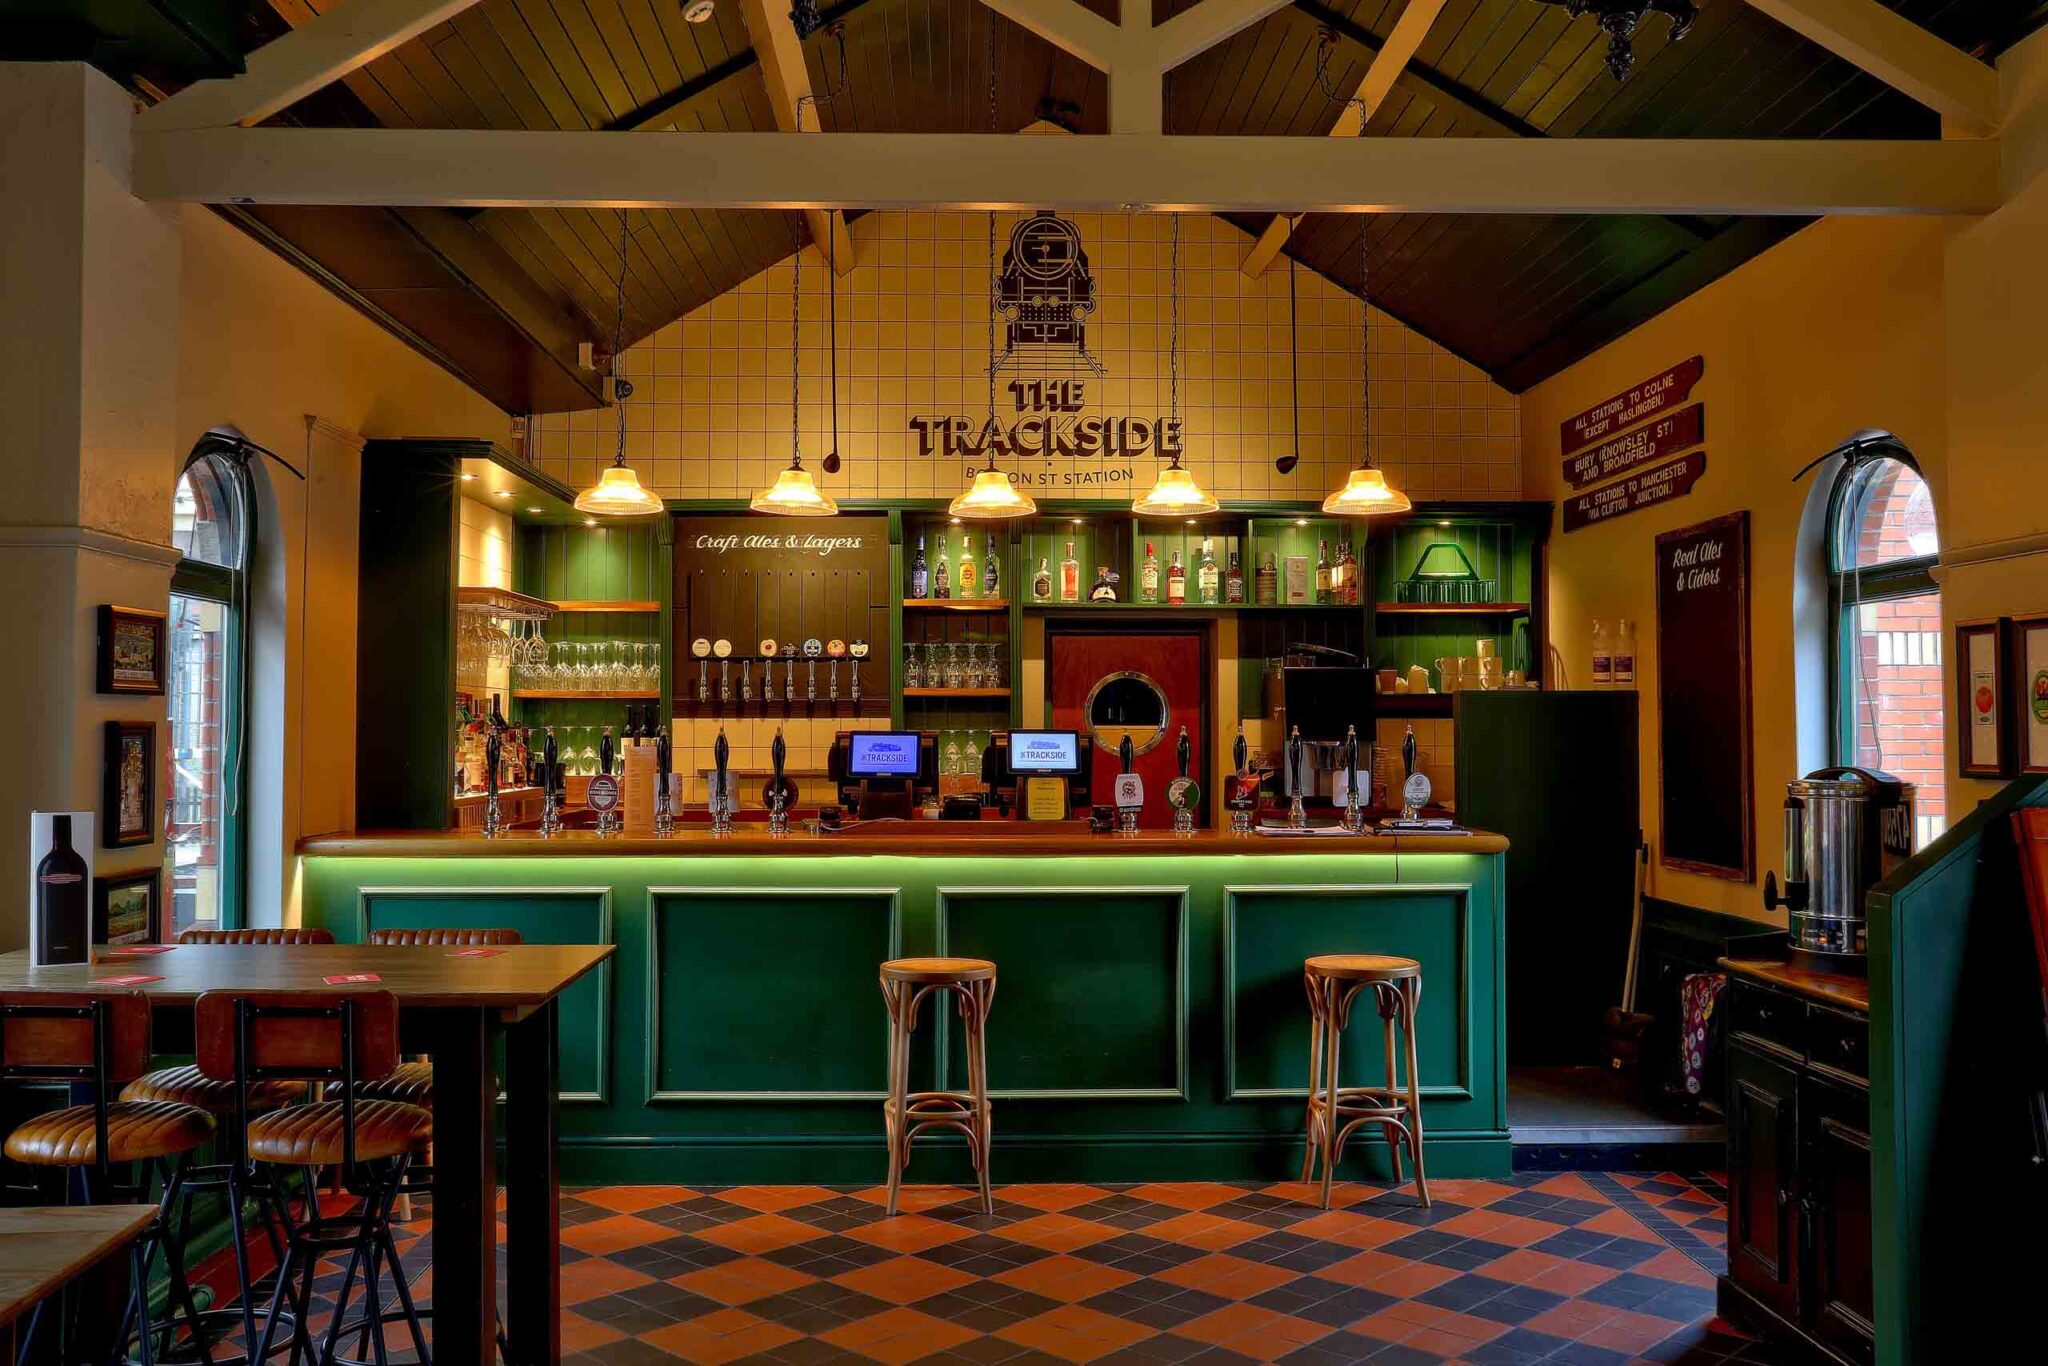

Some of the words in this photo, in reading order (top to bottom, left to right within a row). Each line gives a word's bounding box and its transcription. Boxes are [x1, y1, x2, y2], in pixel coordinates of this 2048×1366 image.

[1008, 379, 1085, 412] THE
[1575, 415, 1587, 431] ALL
[1592, 399, 1624, 423] STATIONS
[1629, 391, 1640, 405] TO
[1644, 374, 1675, 398] COLNE
[909, 414, 1183, 457] TRACKSIDE
[966, 467, 1032, 485] BON
[1038, 473, 1058, 485] ST
[1064, 468, 1134, 485] STATION
[1575, 453, 1595, 473] BURY
[1583, 465, 1599, 482] AND
[1603, 442, 1656, 473] BROADFIELD
[1578, 497, 1590, 511] ALL
[1595, 484, 1625, 505] STATIONS
[1628, 480, 1637, 494] TO
[1641, 461, 1687, 489] MANCHESTER
[1601, 497, 1628, 516] CLIFTON
[696, 534, 738, 554] Craft
[743, 534, 780, 548] Ales
[785, 534, 798, 548] &
[803, 534, 862, 556] Lagers
[1673, 543, 1699, 568] Real
[1700, 539, 1723, 562] Ales
[1677, 572, 1684, 591] &
[1688, 567, 1720, 590] Ciders
